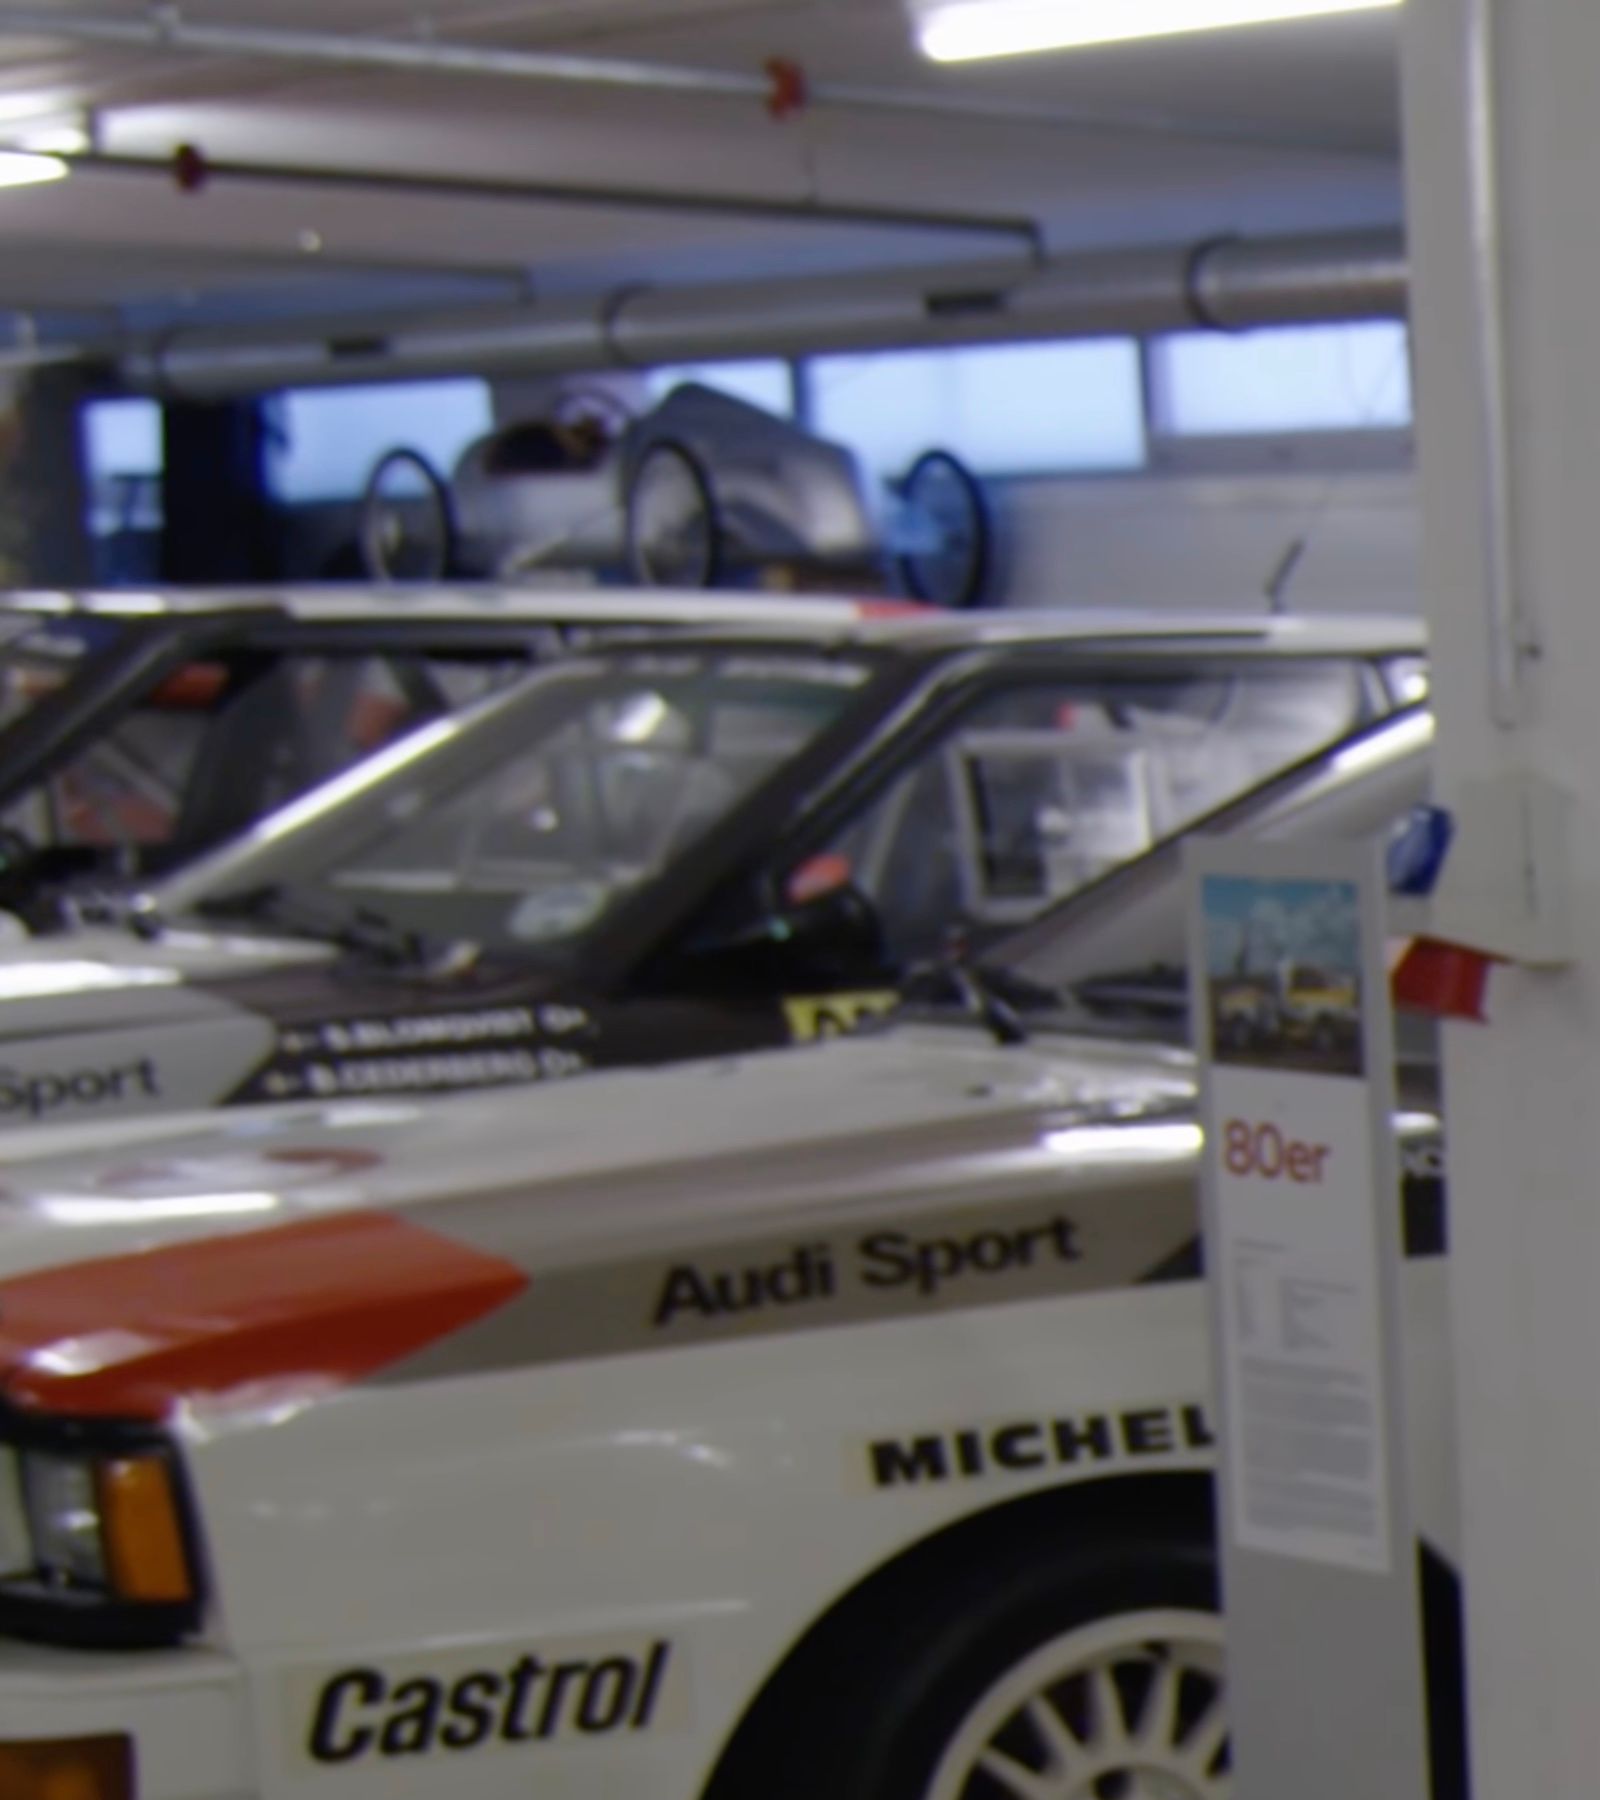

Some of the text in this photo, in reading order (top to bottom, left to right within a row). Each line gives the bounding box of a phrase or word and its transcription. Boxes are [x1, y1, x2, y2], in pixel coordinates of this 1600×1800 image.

[1223, 1118, 1331, 1184] 80er
[653, 1214, 1083, 1327] Audi Sport
[308, 1638, 673, 1763] Castrol
